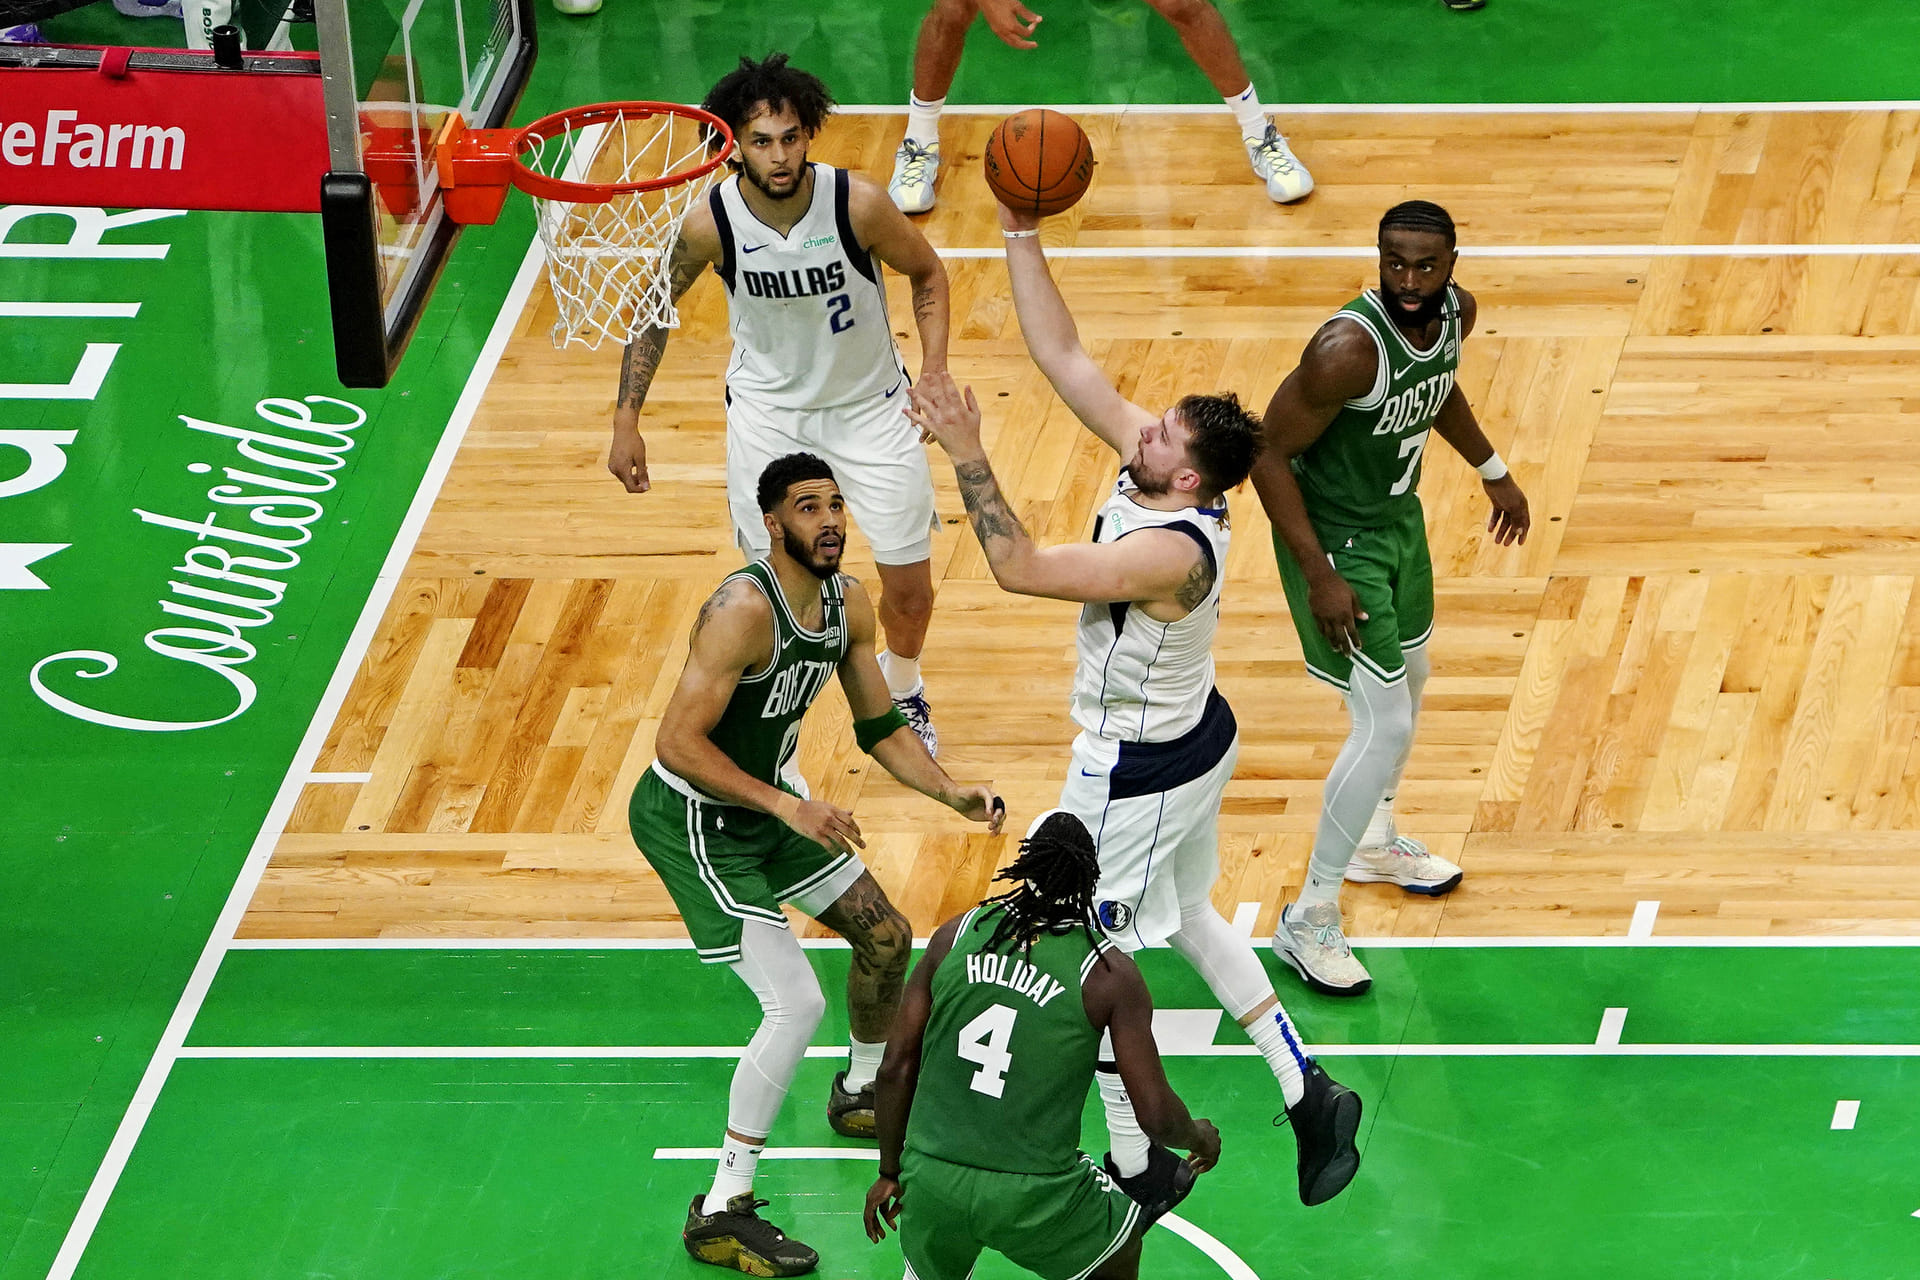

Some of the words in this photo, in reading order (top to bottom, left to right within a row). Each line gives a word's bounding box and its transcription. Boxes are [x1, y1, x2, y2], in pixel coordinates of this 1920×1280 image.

[802, 234, 835, 249] chime
[742, 260, 846, 298] DALLAS
[827, 293, 855, 335] 2
[1389, 429, 1429, 496] 7
[29, 395, 367, 731] Courtside
[966, 952, 1066, 1008] HOLIDAY
[958, 1003, 1018, 1099] 4
